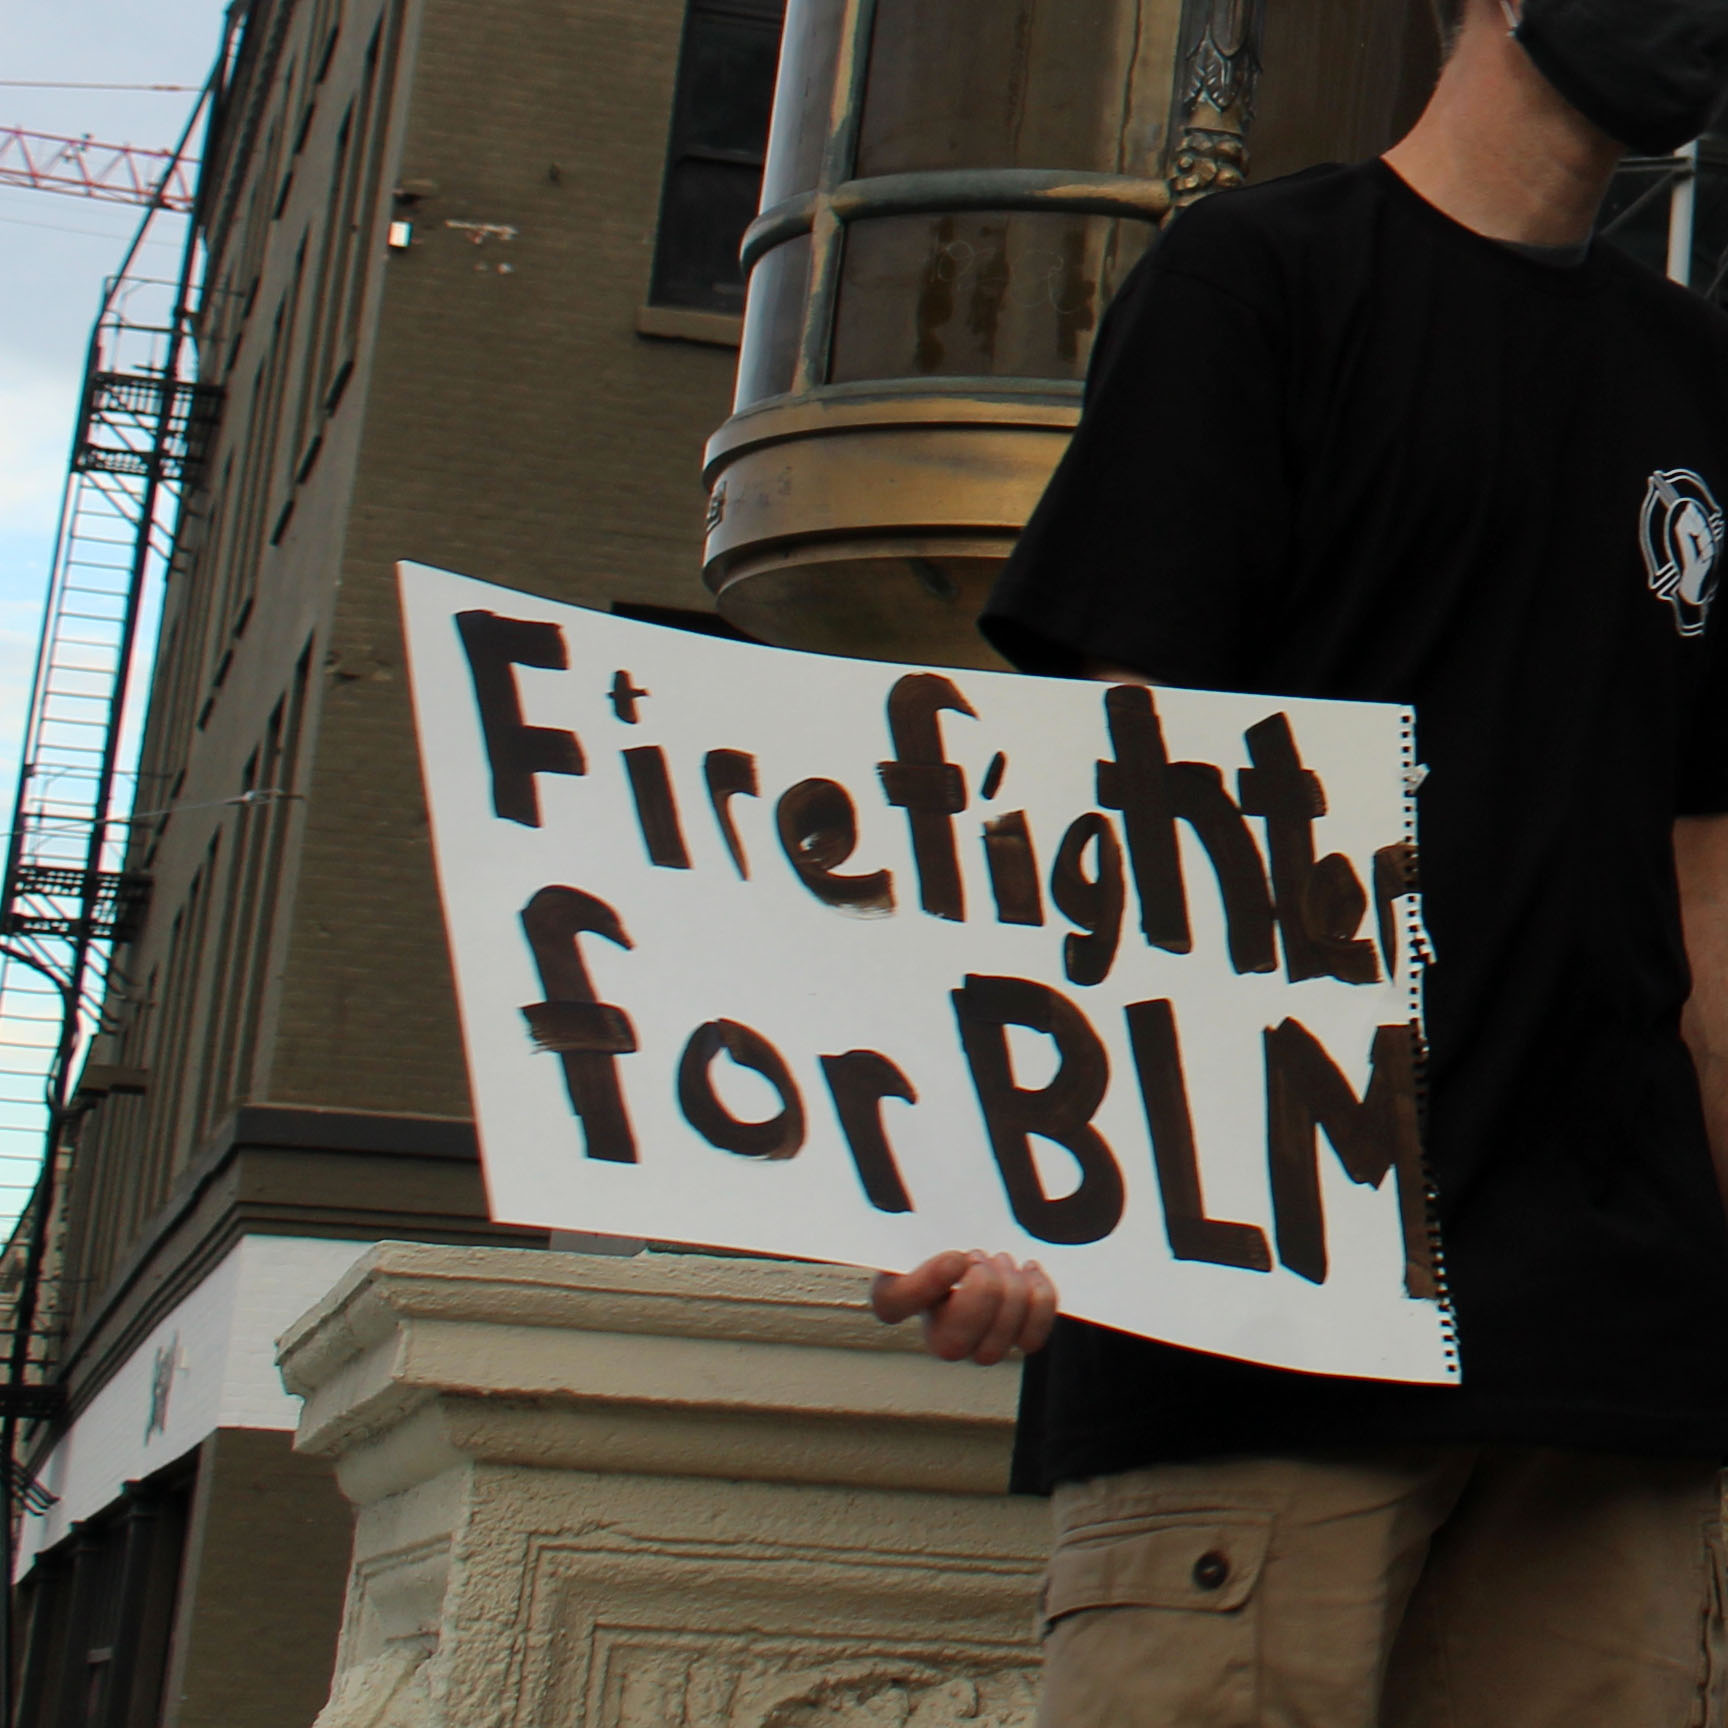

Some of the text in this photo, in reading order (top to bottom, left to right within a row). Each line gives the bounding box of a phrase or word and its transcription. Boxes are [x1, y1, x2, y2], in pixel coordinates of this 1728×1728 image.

[456, 610, 1419, 986] Firefighter
[519, 883, 1436, 1300] for BLM
